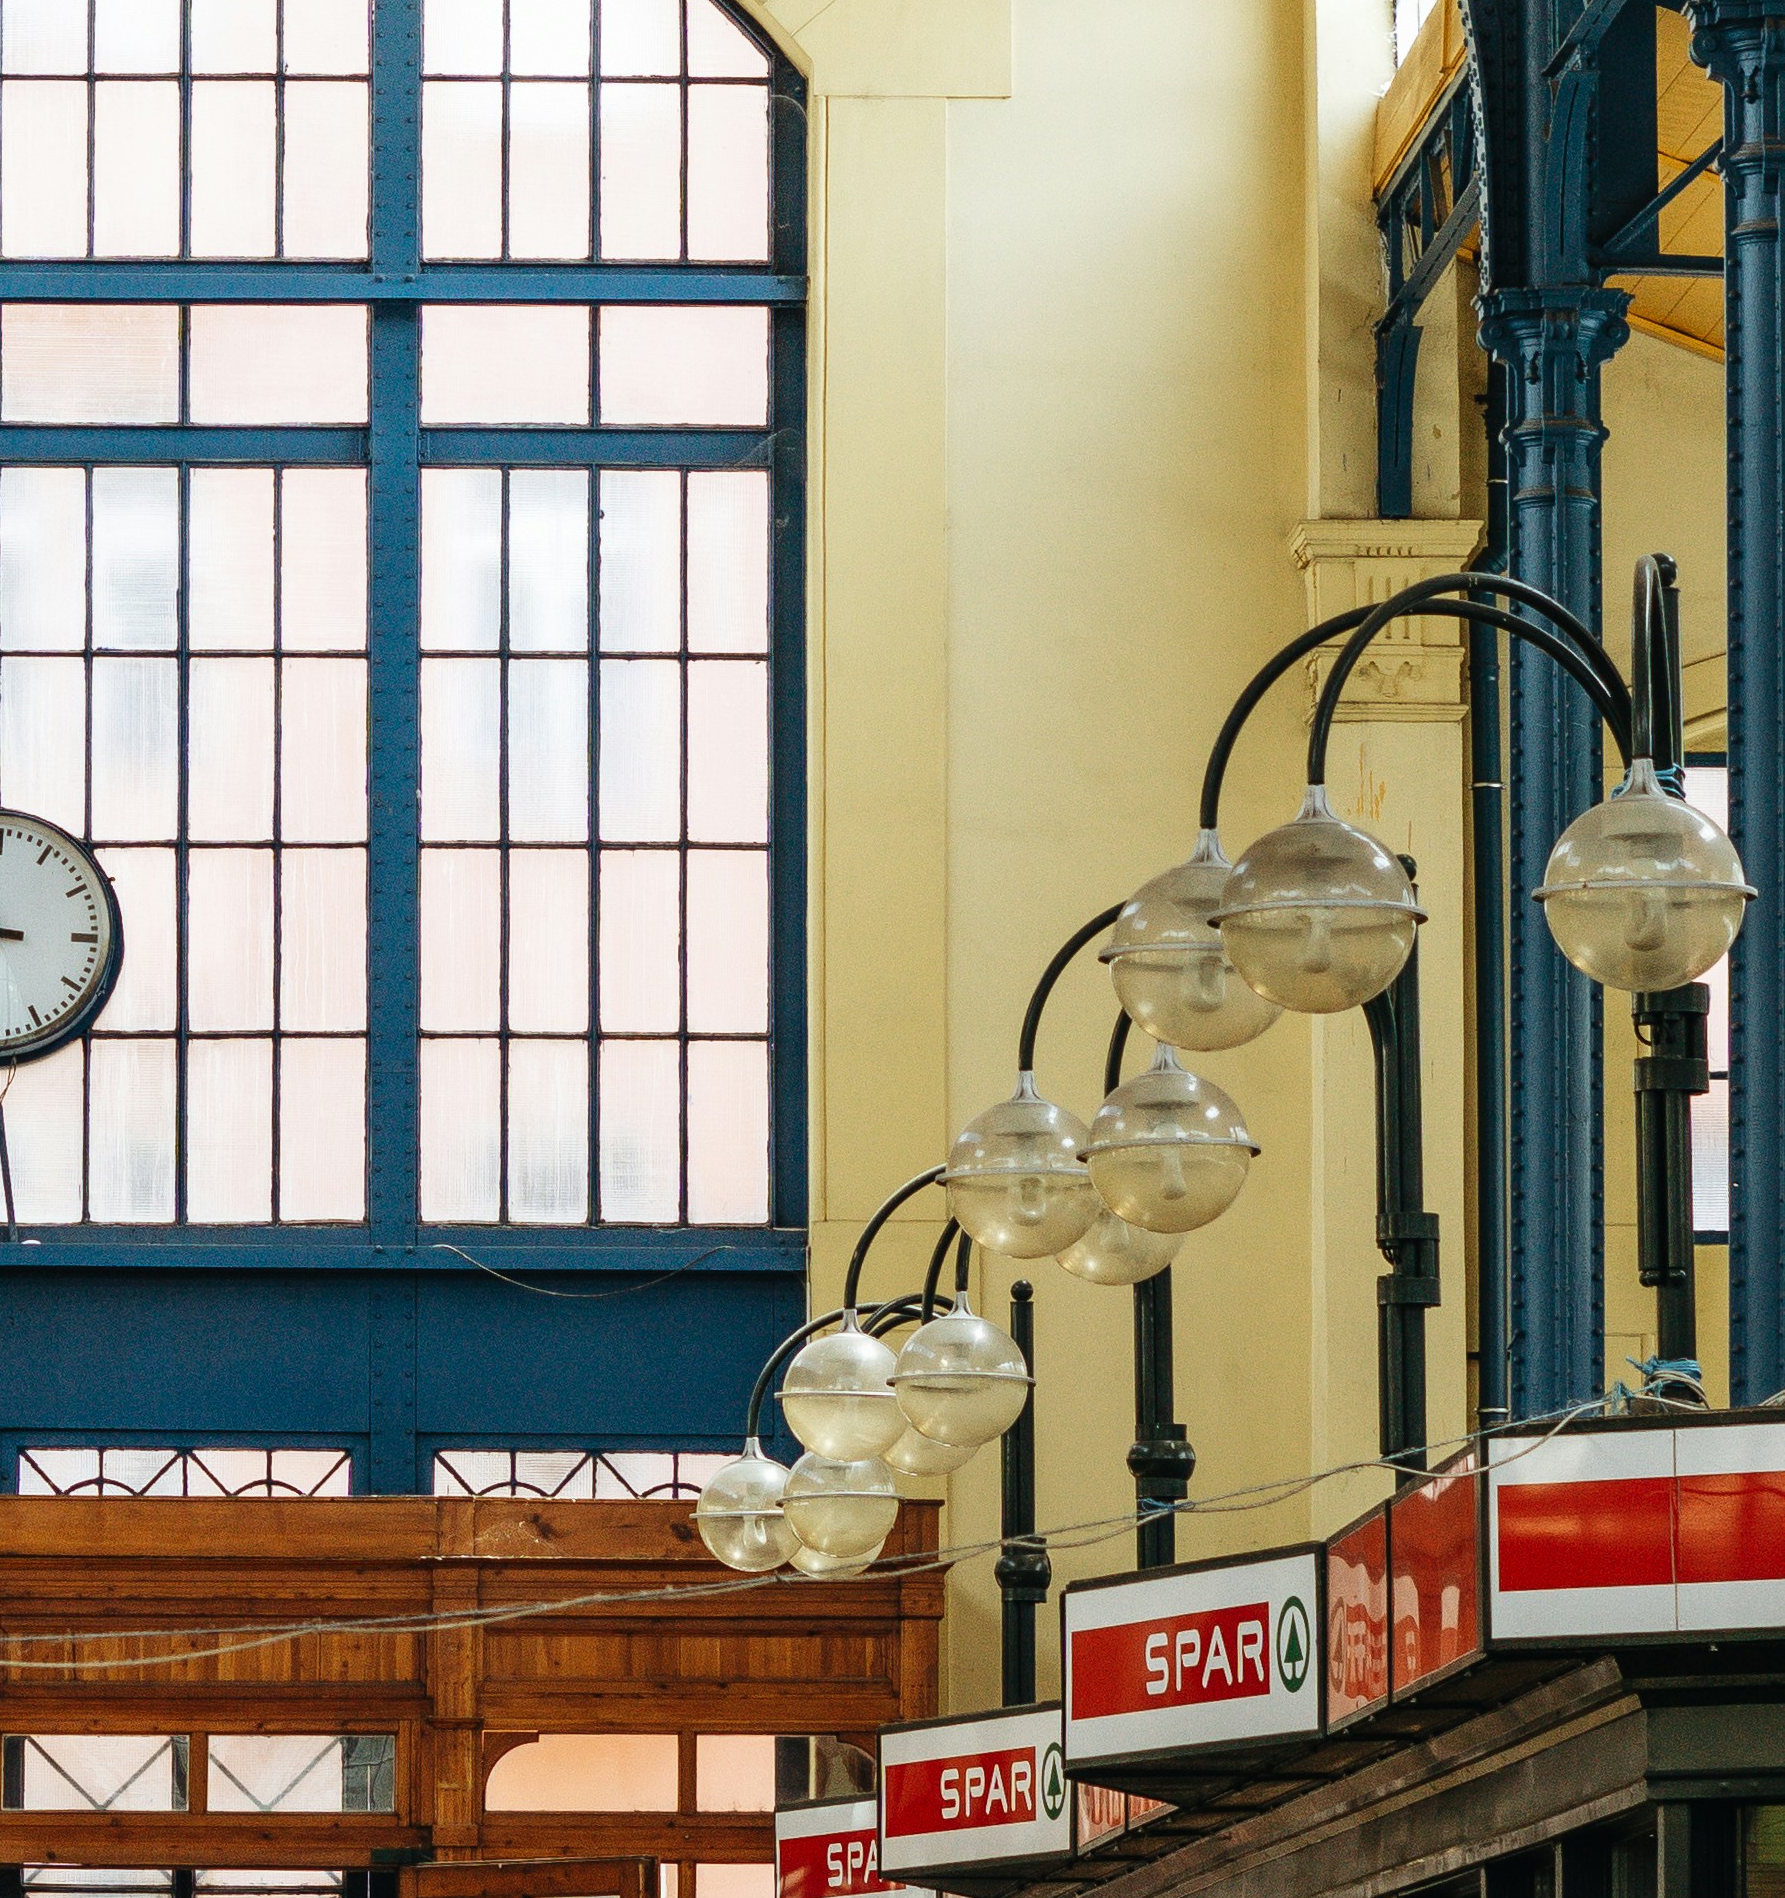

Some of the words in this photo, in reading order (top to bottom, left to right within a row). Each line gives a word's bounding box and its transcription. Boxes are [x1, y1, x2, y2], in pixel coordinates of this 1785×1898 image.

[1144, 1619, 1265, 1696] SPAR
[939, 1760, 1033, 1819] SPAR
[826, 1838, 878, 1889] SPA
